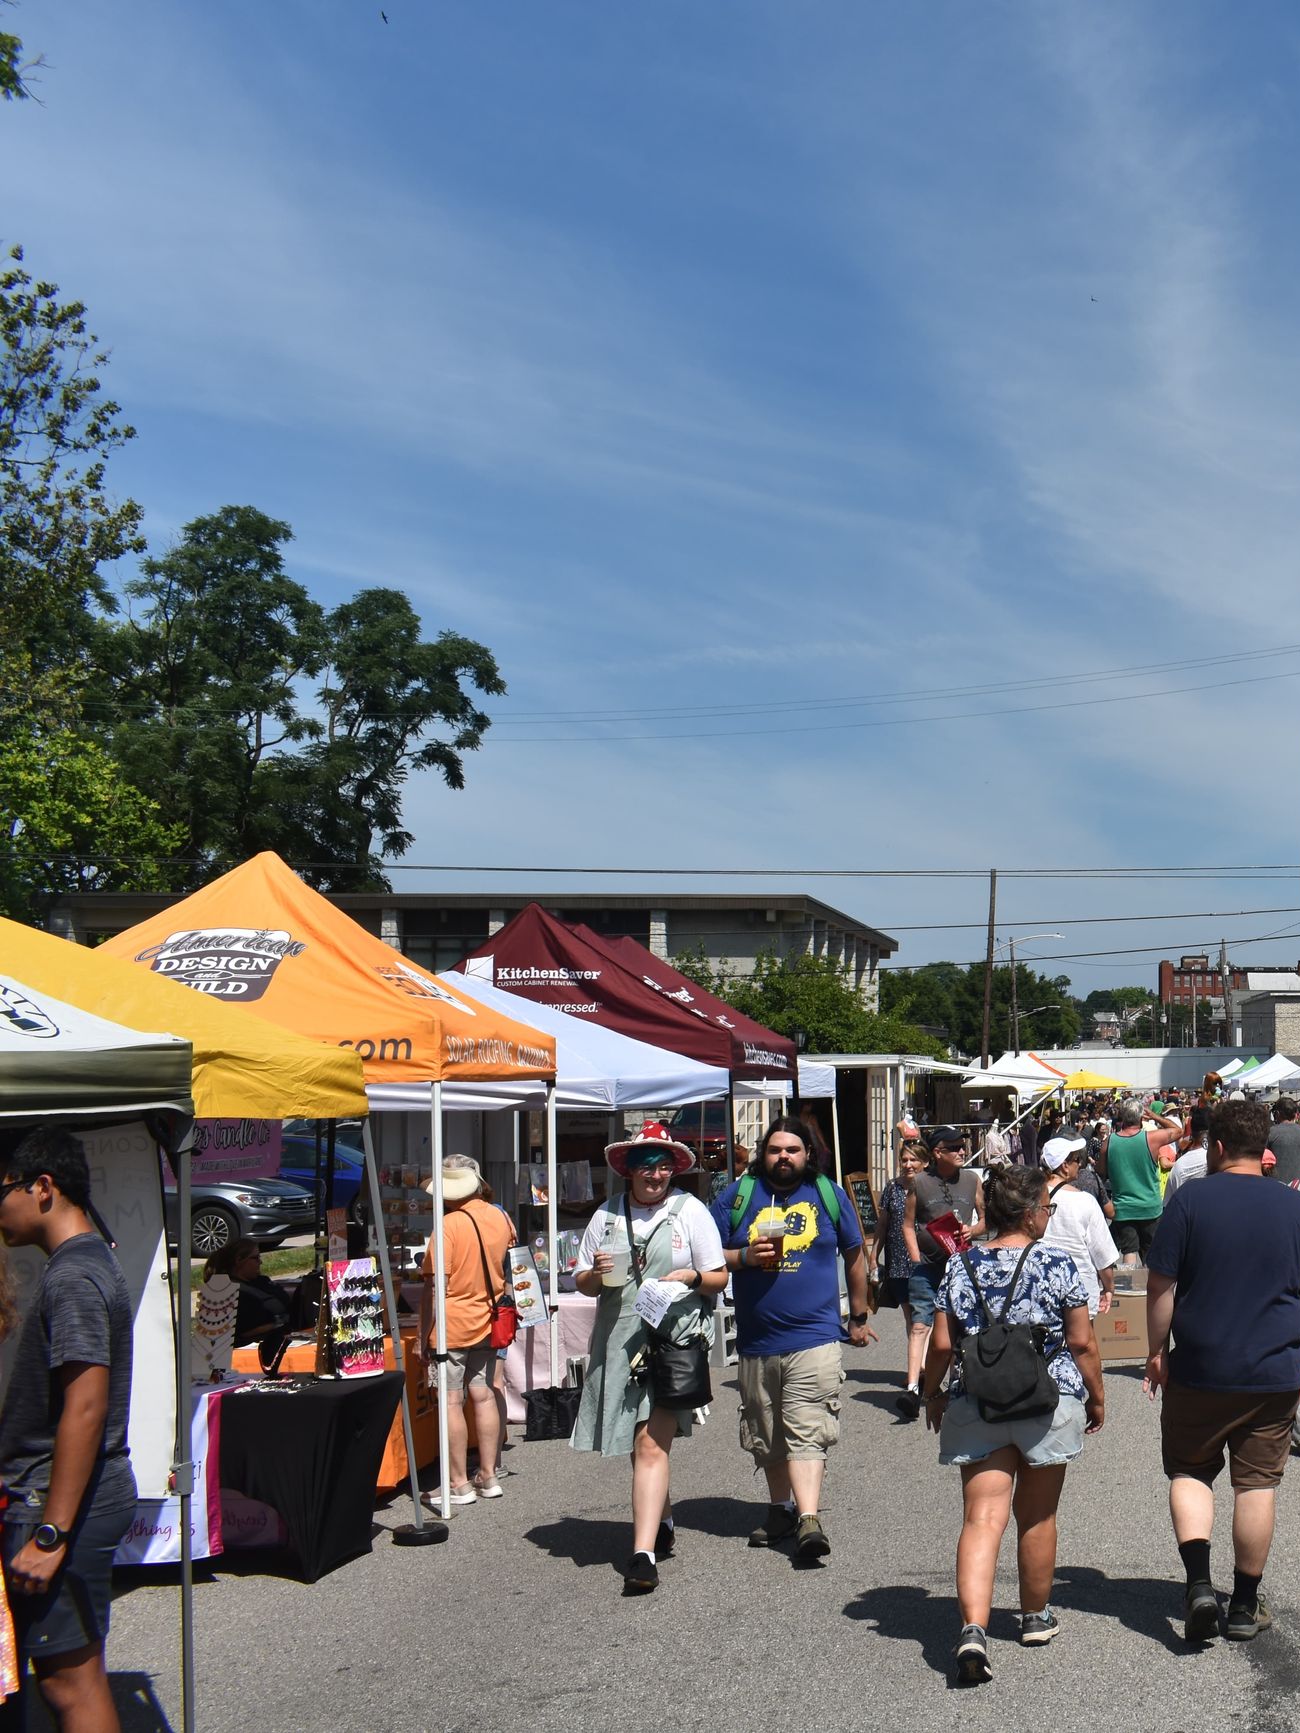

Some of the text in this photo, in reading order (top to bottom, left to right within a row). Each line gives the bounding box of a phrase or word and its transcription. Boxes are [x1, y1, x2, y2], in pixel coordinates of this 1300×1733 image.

[135, 931, 307, 962] American
[155, 956, 275, 972] DESIGN
[194, 970, 222, 979] and
[497, 967, 602, 980] KitchenSaver
[180, 981, 249, 995] UILD
[214, 1119, 257, 1151] Candle
